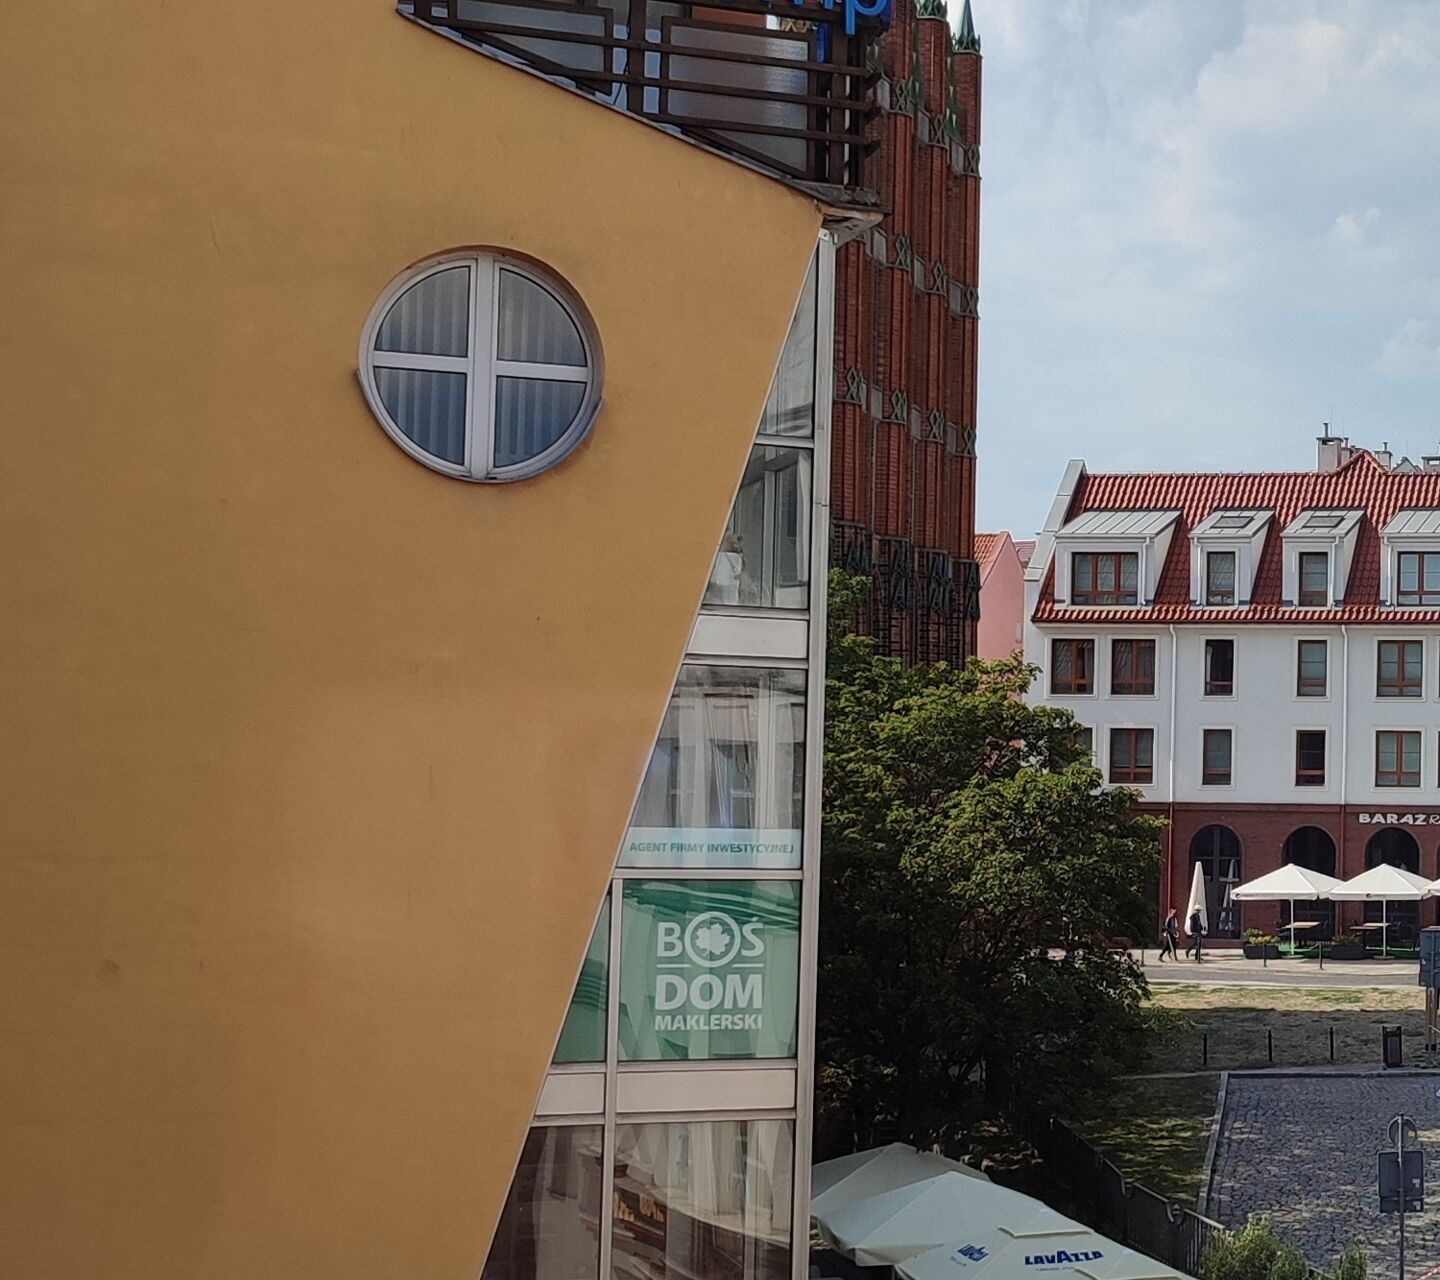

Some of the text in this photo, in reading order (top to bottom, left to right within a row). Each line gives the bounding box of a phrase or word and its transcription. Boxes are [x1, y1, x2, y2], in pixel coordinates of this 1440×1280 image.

[629, 842, 794, 854] AGENT FIRMY INWESTYCYJNEJ
[654, 973, 763, 1011] DOM
[654, 1014, 763, 1031] MAKLERSKI
[1024, 1250, 1105, 1266] LAVAZZA
